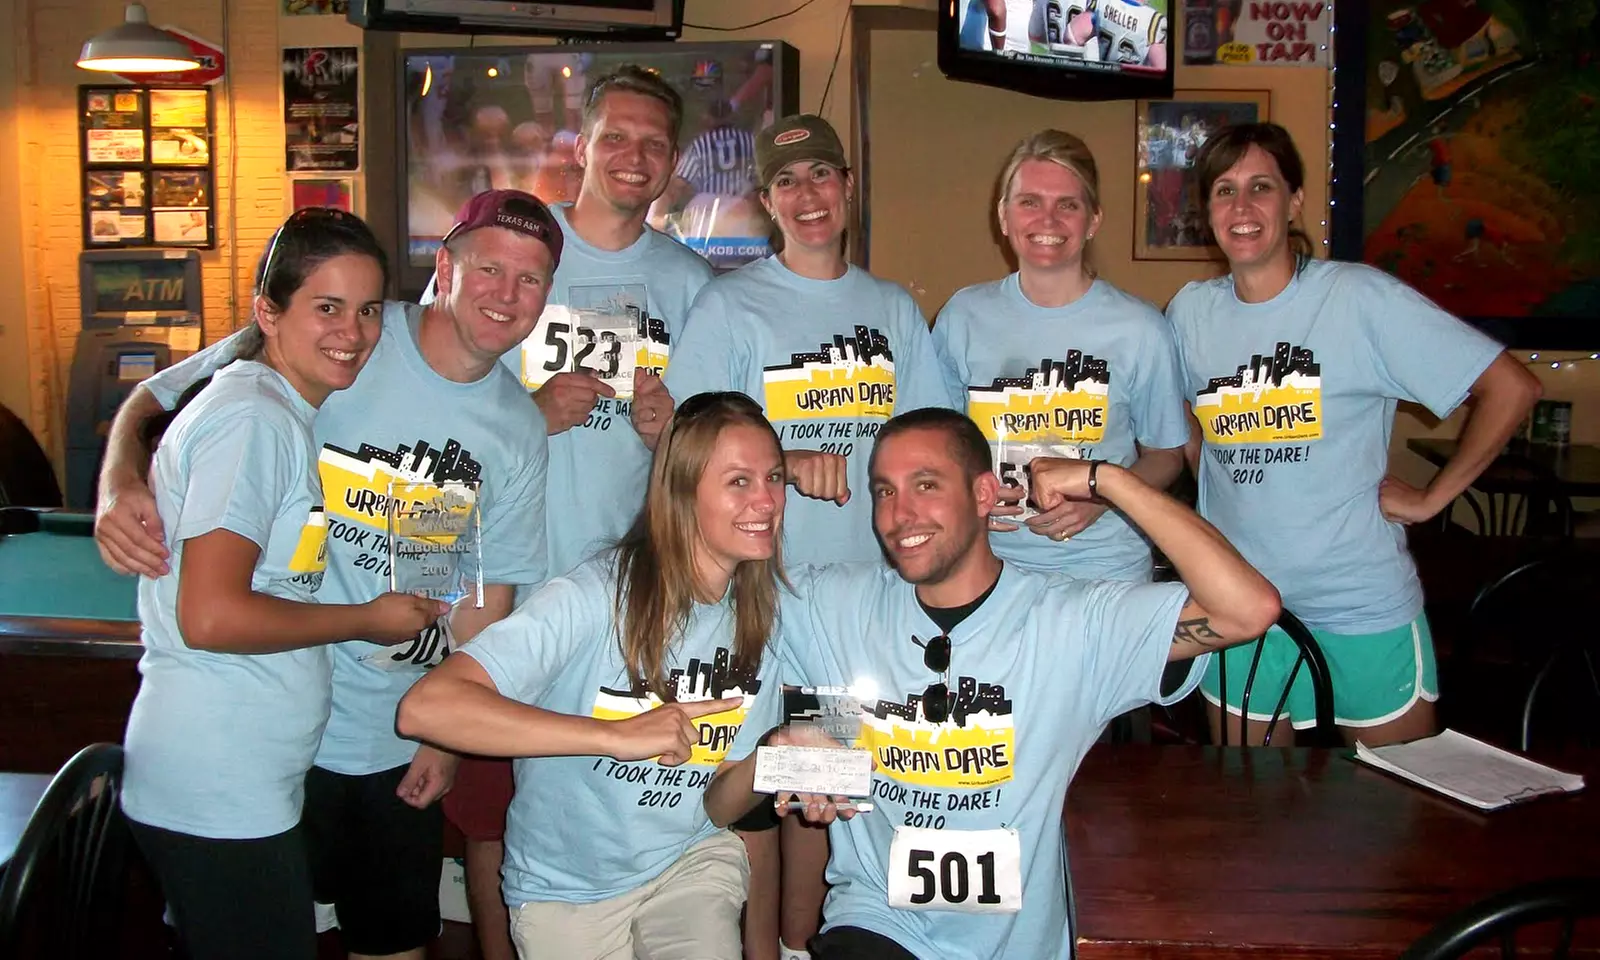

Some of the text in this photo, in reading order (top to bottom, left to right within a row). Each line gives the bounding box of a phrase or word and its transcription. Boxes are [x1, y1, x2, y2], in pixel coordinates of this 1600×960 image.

[1103, 4, 1138, 32] SHELLER
[1249, 2, 1324, 21] NOW
[1265, 22, 1306, 41] ON
[1256, 43, 1315, 62] TAP!
[497, 214, 540, 232] TEXAS A&M
[708, 246, 767, 256] KOB.COM
[123, 277, 185, 301] ATM
[542, 321, 622, 379] 523
[592, 400, 632, 416] HE DA
[797, 381, 893, 411] URBAN DARE
[780, 422, 884, 441] I TOOK THE DAR
[1054, 408, 1103, 432] DARE
[1210, 402, 1317, 437] URBAN DARE
[1240, 448, 1261, 464] THE
[1233, 468, 1264, 484] 2010
[346, 488, 405, 518] URBAN
[328, 518, 370, 548] TOOK
[371, 534, 391, 555] TH
[699, 723, 742, 752] DAR
[879, 746, 940, 773] URBAN
[944, 744, 1008, 774] DARE
[592, 758, 603, 771] I
[606, 761, 652, 785] TOOK
[654, 768, 686, 788] THE
[637, 790, 682, 808] 2010
[872, 779, 907, 807] TOOK
[912, 790, 940, 810] THE
[904, 811, 946, 830] 2010
[908, 849, 1002, 904] 501
